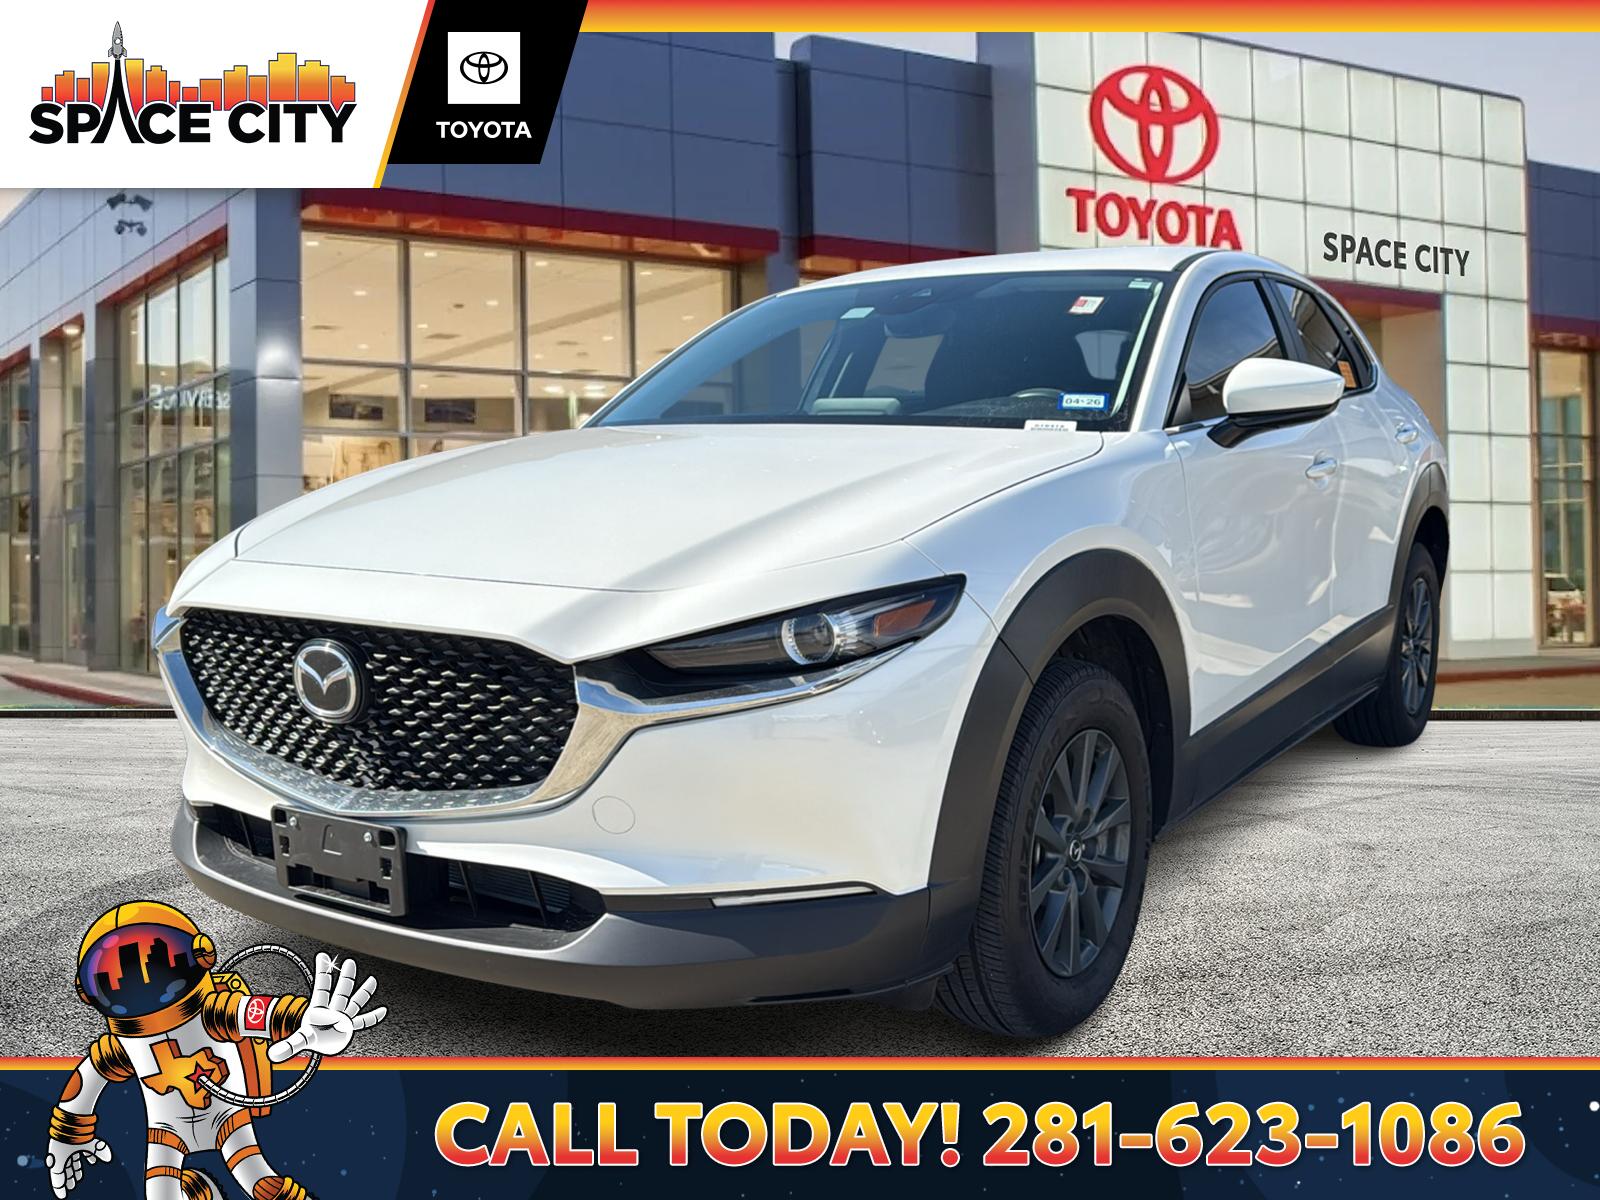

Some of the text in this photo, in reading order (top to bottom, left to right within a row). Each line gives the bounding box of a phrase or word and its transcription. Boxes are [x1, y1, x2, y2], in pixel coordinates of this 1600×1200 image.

[1065, 187, 1243, 251] TOYOTA
[1323, 231, 1470, 277] SPACE CITY
